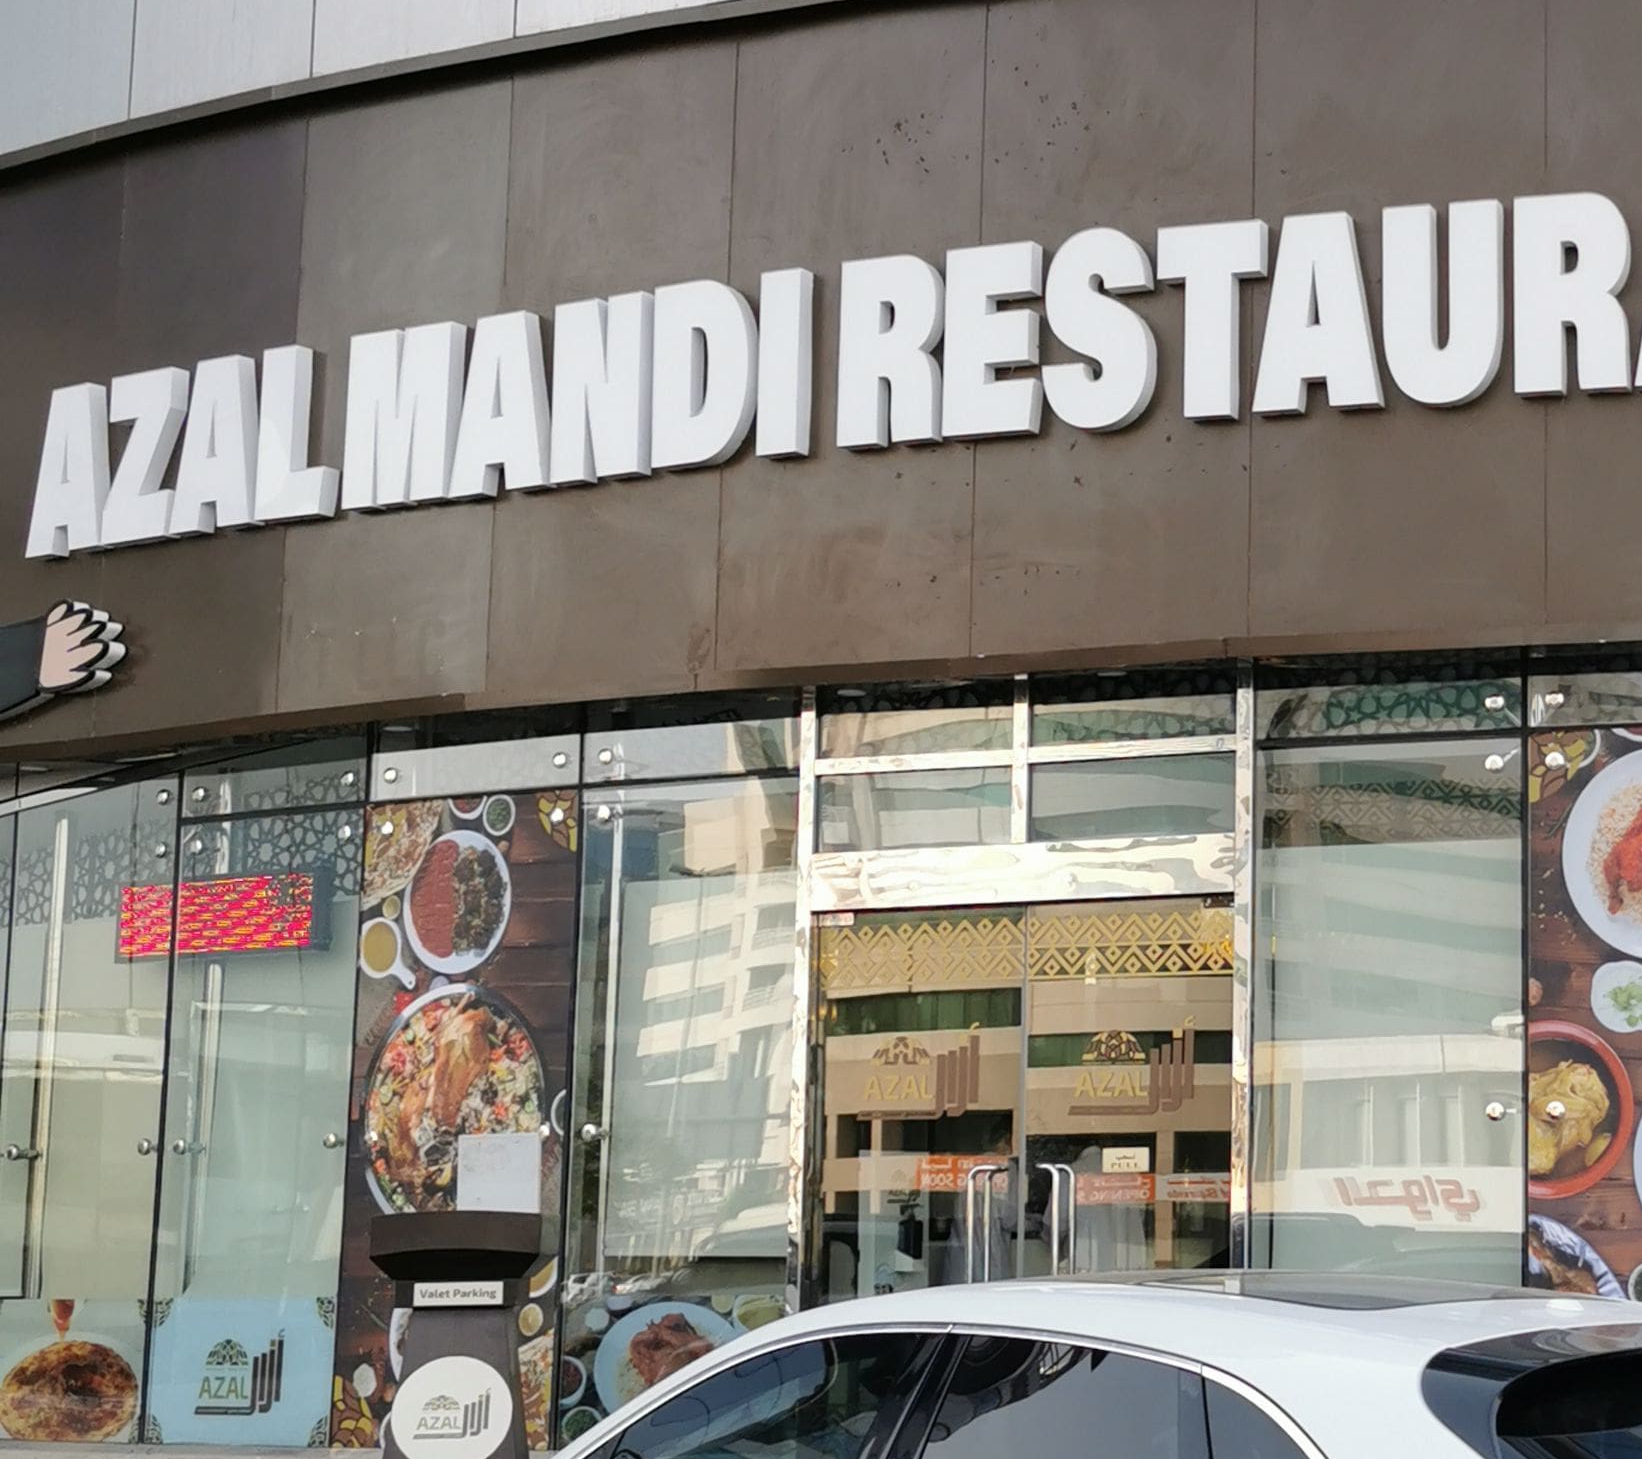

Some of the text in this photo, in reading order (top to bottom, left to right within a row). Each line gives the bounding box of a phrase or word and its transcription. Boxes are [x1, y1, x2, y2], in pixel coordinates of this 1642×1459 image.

[25, 345, 339, 558] AZAL
[341, 267, 814, 511] MANDI
[863, 1074, 935, 1100] AZAL
[1074, 1070, 1148, 1098] AZAL
[420, 1288, 497, 1300] Valet Parking
[199, 1376, 249, 1399] AZAL
[416, 1416, 462, 1431] AZAL
